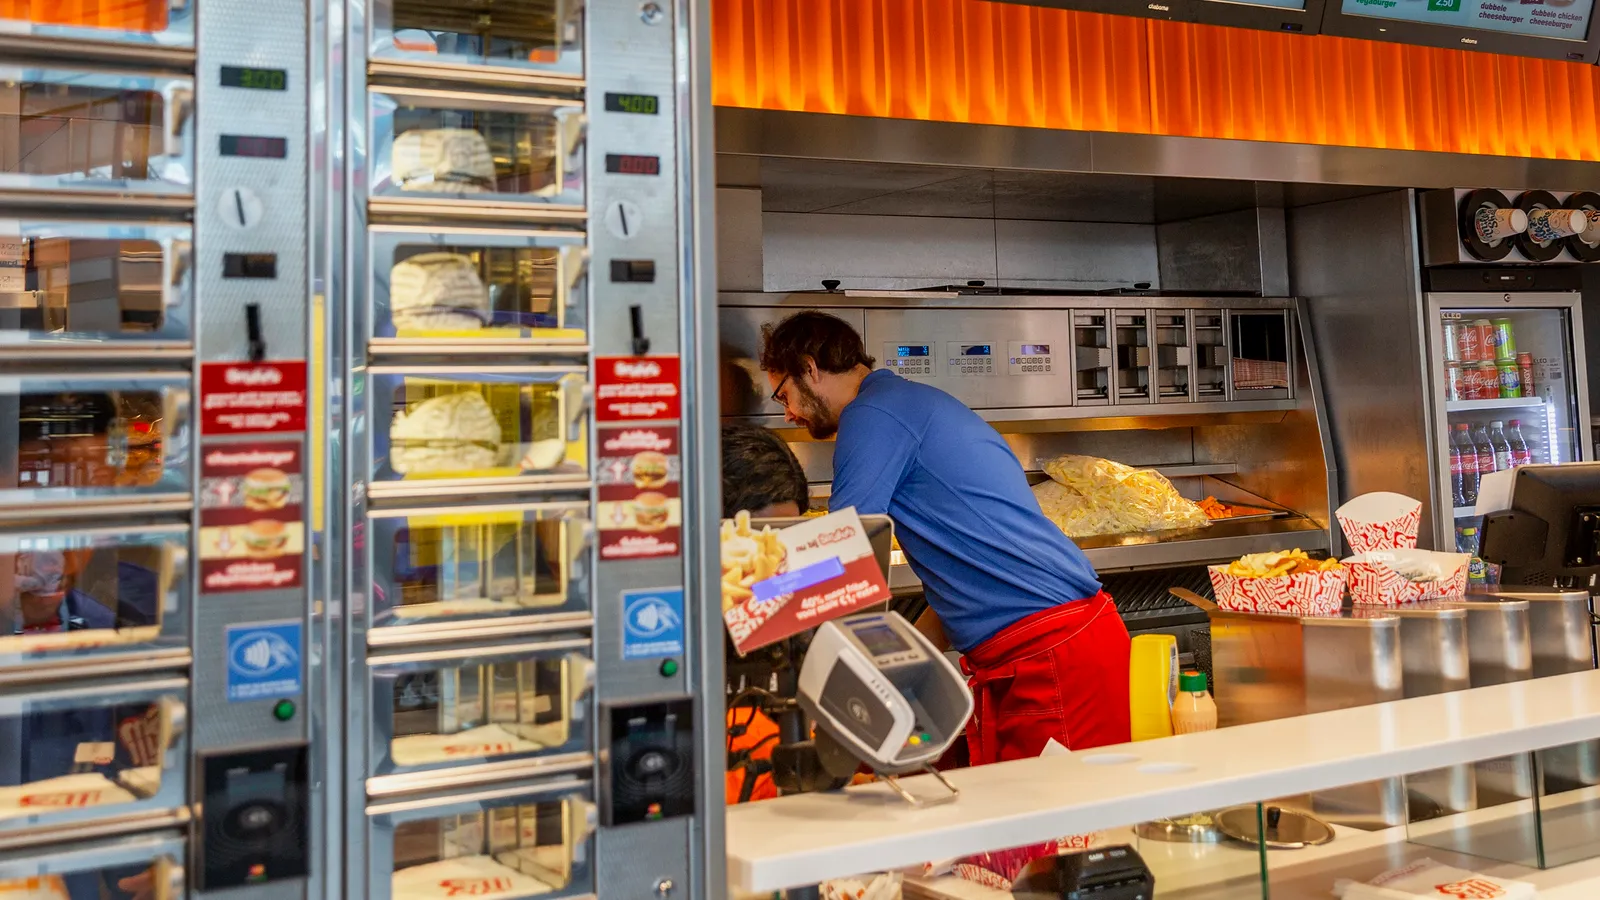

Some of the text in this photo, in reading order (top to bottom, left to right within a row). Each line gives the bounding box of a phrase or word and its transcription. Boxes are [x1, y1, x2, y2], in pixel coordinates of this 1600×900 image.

[1480, 2, 1507, 12] dubbele
[1478, 11, 1524, 23] cheeseburger
[1531, 8, 1583, 21] dubbele chicken
[1529, 17, 1573, 29] cheeseburger
